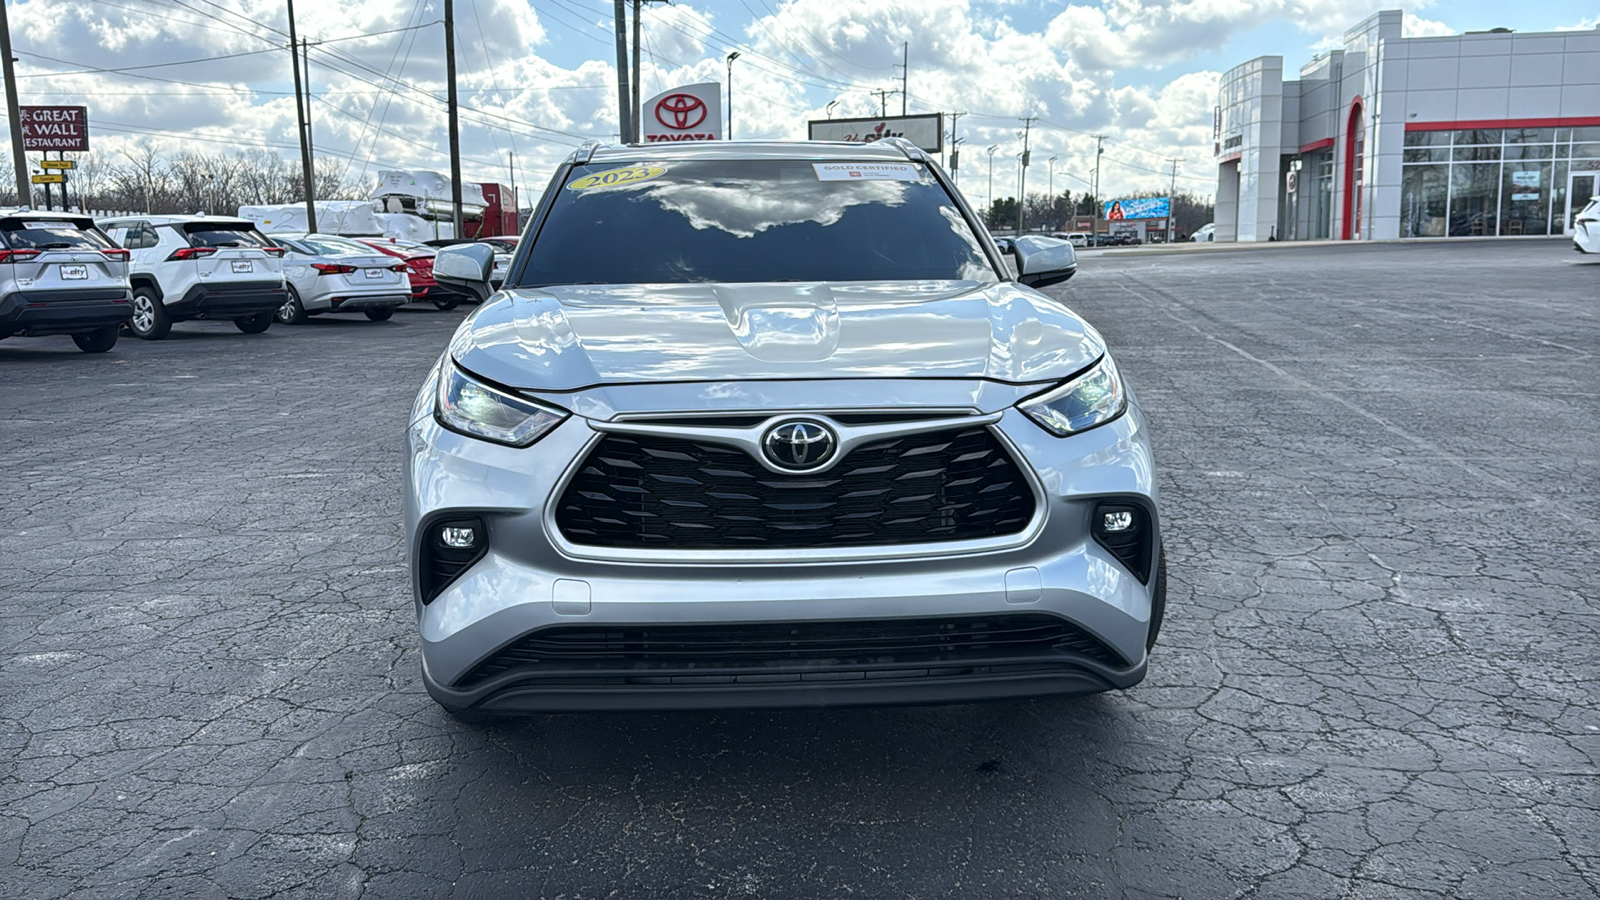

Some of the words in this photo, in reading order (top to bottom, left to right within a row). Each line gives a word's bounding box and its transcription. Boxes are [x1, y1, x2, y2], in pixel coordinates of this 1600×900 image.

[33, 110, 78, 121] GREAT
[34, 124, 78, 135] WALL
[25, 138, 81, 147] ESTAURANT
[586, 167, 651, 188] 2023
